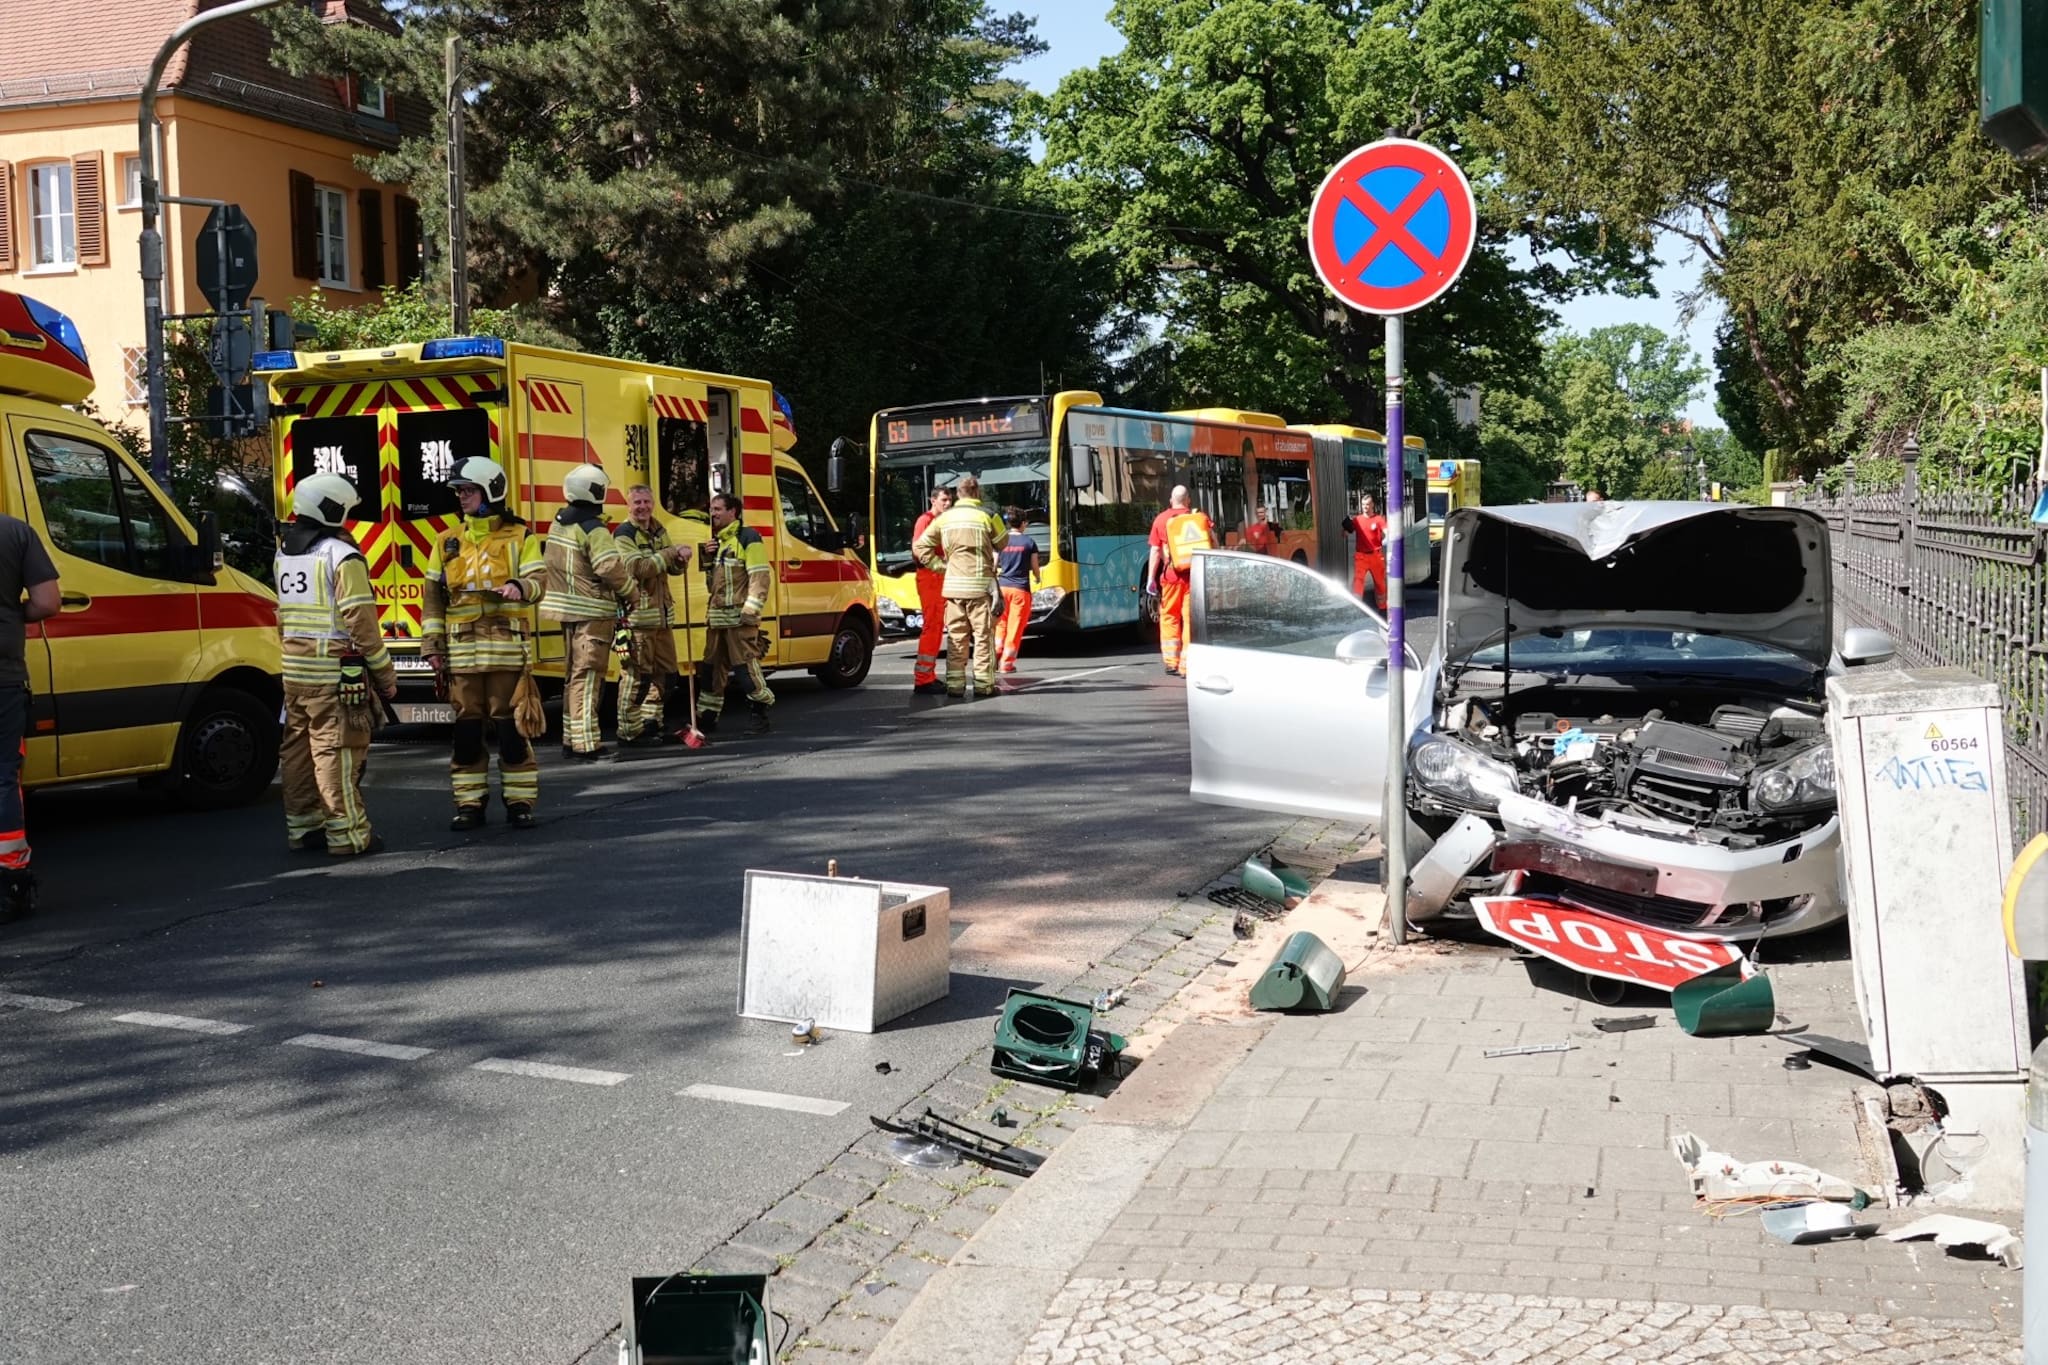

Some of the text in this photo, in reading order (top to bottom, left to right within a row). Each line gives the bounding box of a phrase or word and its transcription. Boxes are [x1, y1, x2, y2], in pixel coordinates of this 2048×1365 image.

[888, 413, 1013, 443] 63 Pillnitz
[280, 571, 308, 594] C-3
[411, 707, 452, 722] fahrtec
[1931, 737, 1979, 751] 60564
[1509, 912, 1722, 975] STOP
[1087, 1045, 1102, 1069] K12
